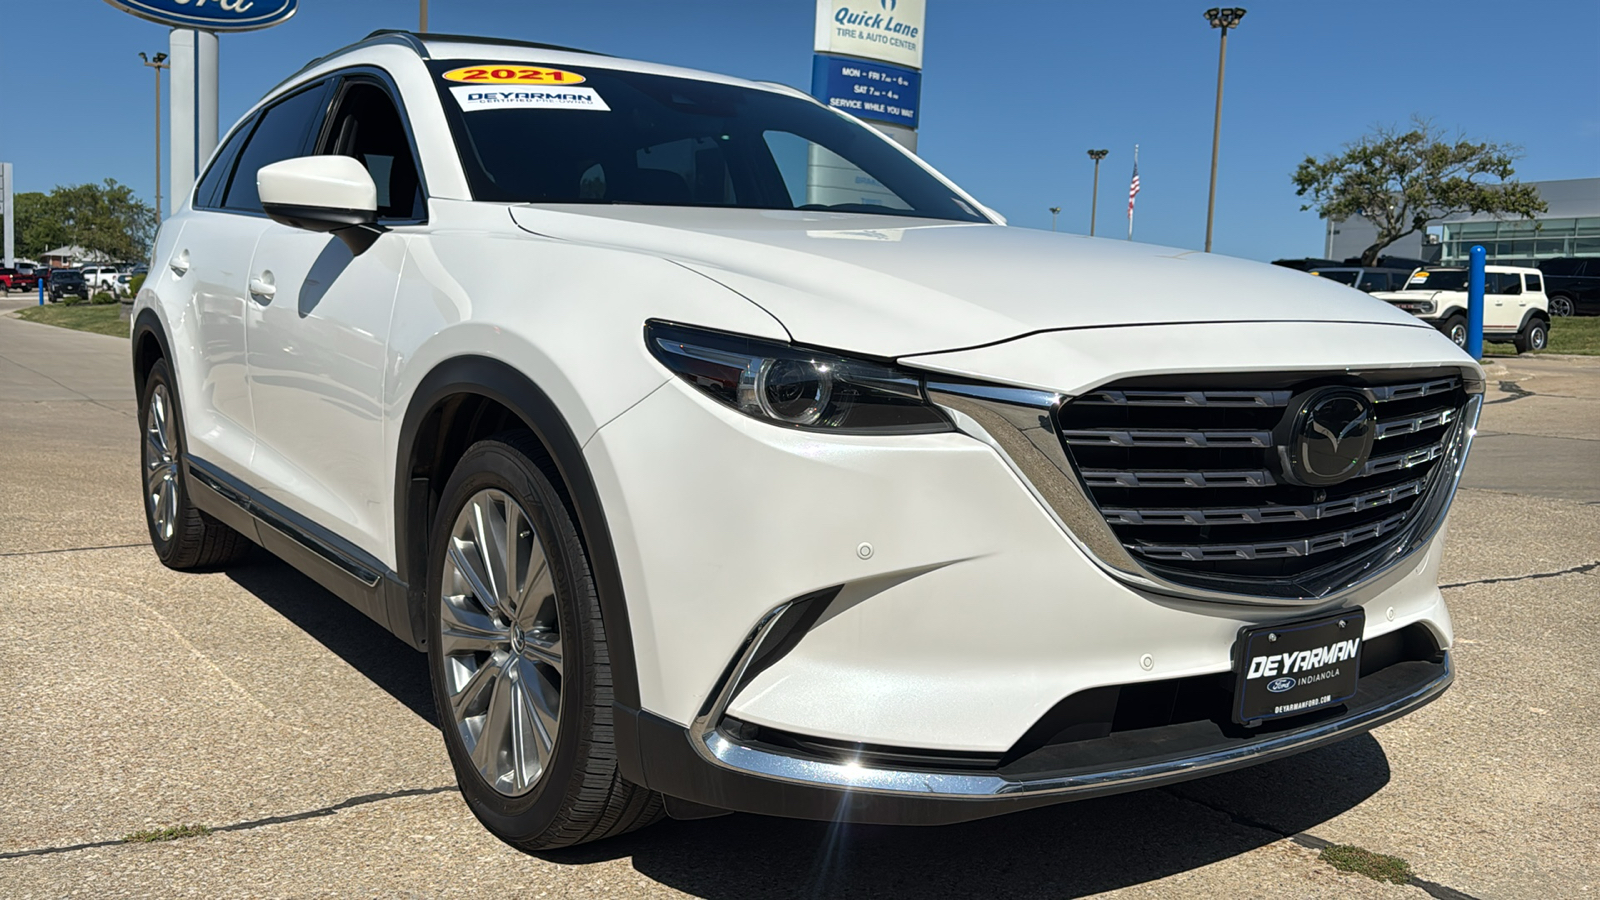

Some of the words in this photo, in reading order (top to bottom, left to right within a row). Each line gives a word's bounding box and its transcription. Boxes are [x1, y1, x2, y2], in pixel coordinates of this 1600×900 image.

[834, 7, 883, 29] Quick
[884, 16, 919, 38] Lane
[836, 28, 857, 39] TIRE
[858, 31, 864, 39] &
[866, 33, 888, 44] AUTO
[889, 37, 916, 51] CENTER
[462, 69, 565, 81] 2021
[842, 67, 860, 78] MON
[868, 71, 880, 81] FRI
[468, 92, 592, 101] DEYARMAN
[853, 84, 868, 94] SAT
[830, 97, 862, 109] SERVICE
[864, 102, 885, 113] WHILE
[887, 105, 900, 115] YOU
[1246, 637, 1360, 679] DEYARMAN
[1272, 680, 1291, 690] Ford
[1297, 668, 1340, 686] INDIANOLA
[1274, 695, 1331, 714] DEYARMANFORD.COM
